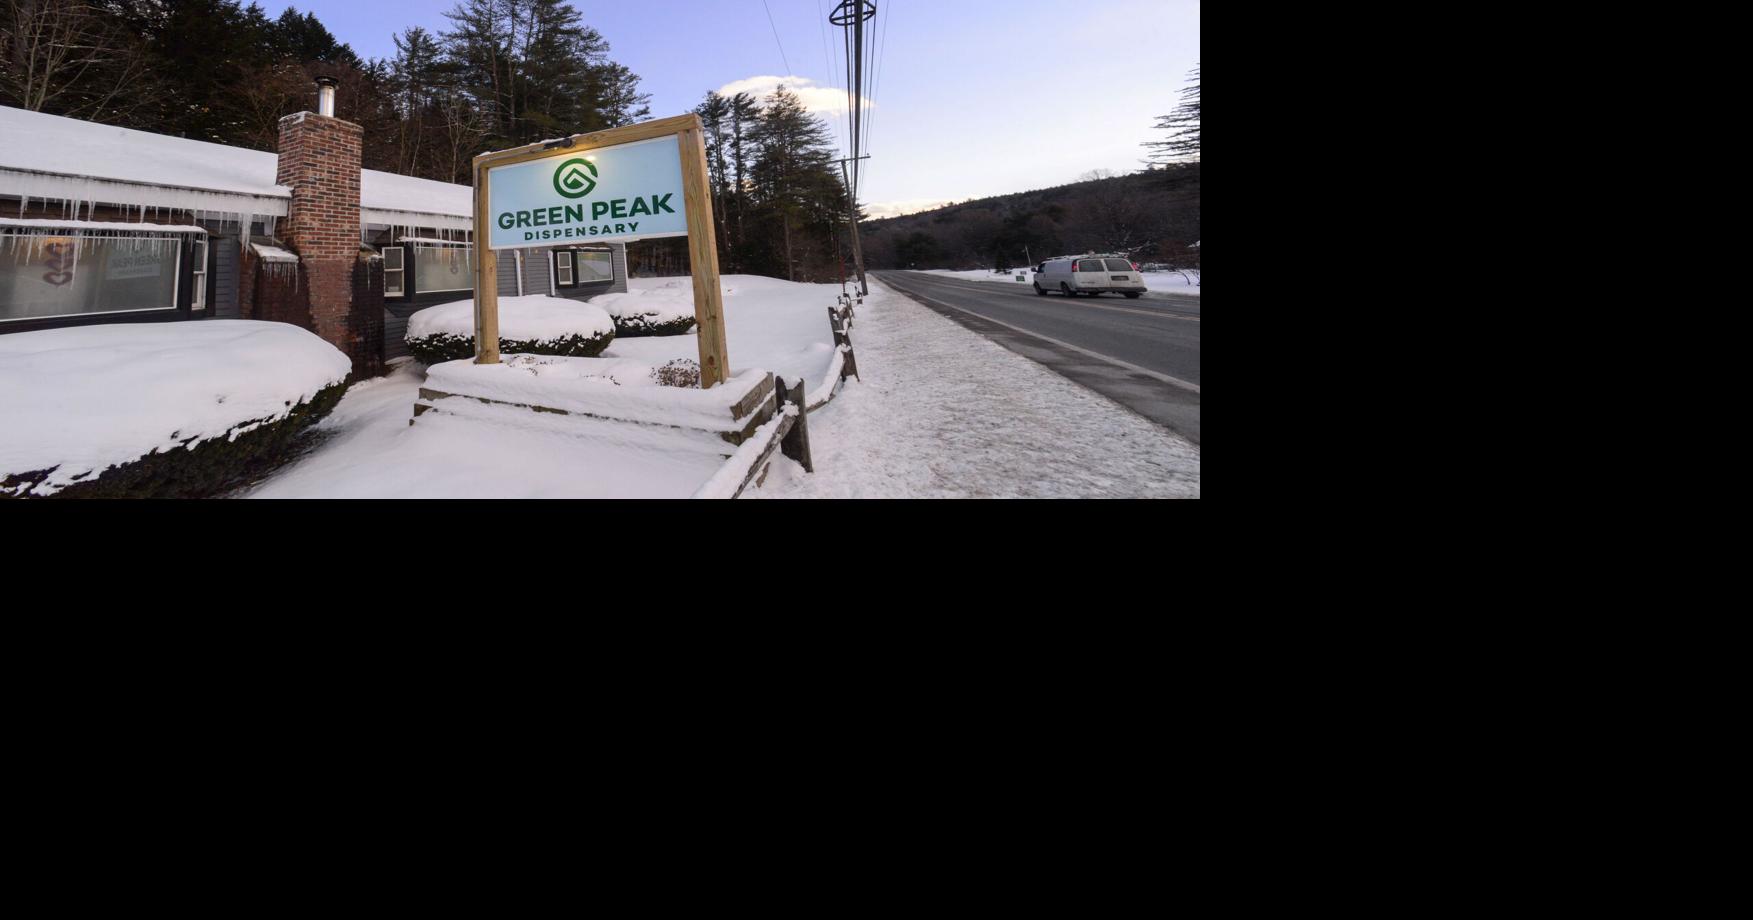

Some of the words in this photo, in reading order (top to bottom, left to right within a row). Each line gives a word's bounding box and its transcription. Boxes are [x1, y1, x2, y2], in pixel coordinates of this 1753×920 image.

[498, 203, 584, 230] GREEN
[591, 192, 676, 221] PEAK
[524, 221, 639, 241] DISPENSARY
